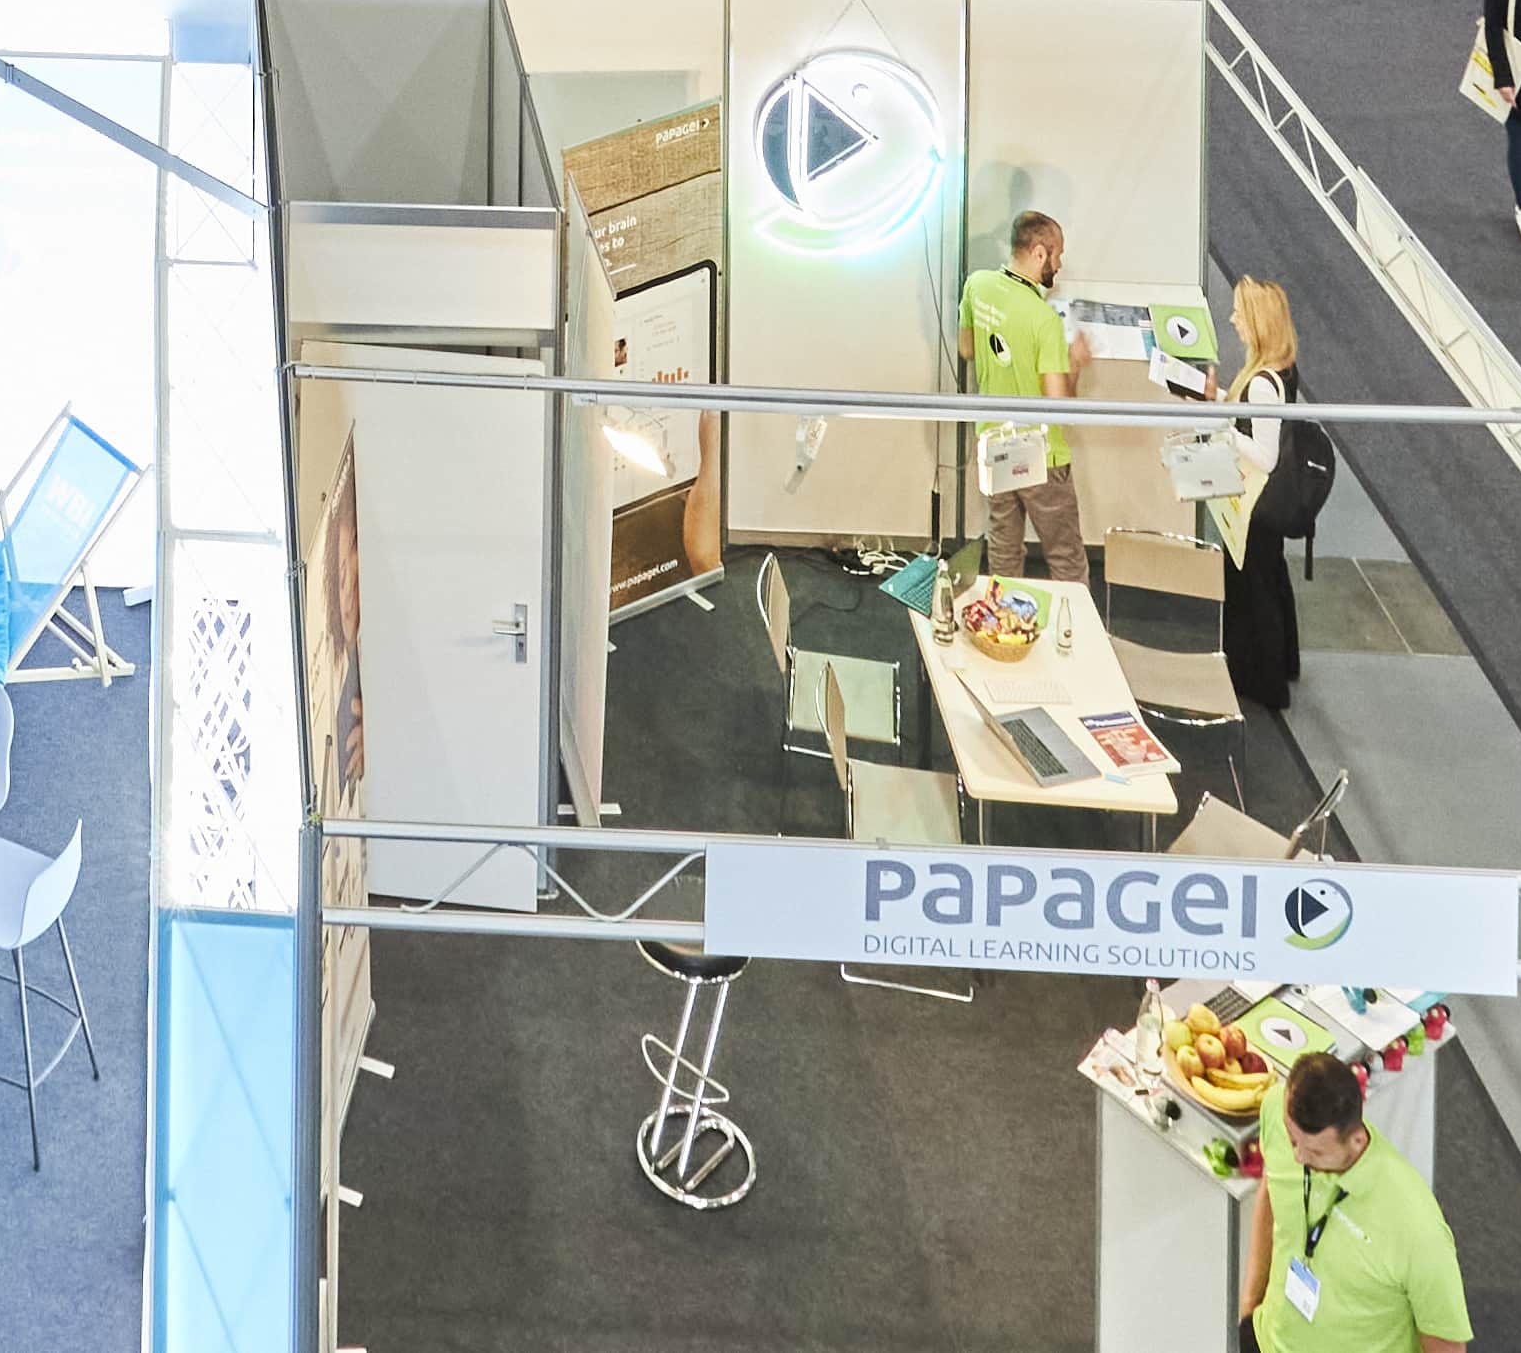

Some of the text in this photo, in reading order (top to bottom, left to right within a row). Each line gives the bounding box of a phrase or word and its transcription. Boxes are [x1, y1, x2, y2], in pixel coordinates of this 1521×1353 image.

[609, 215, 638, 236] brain
[863, 934, 1257, 972] DIGITAL LEARNING SOLUTIONS
